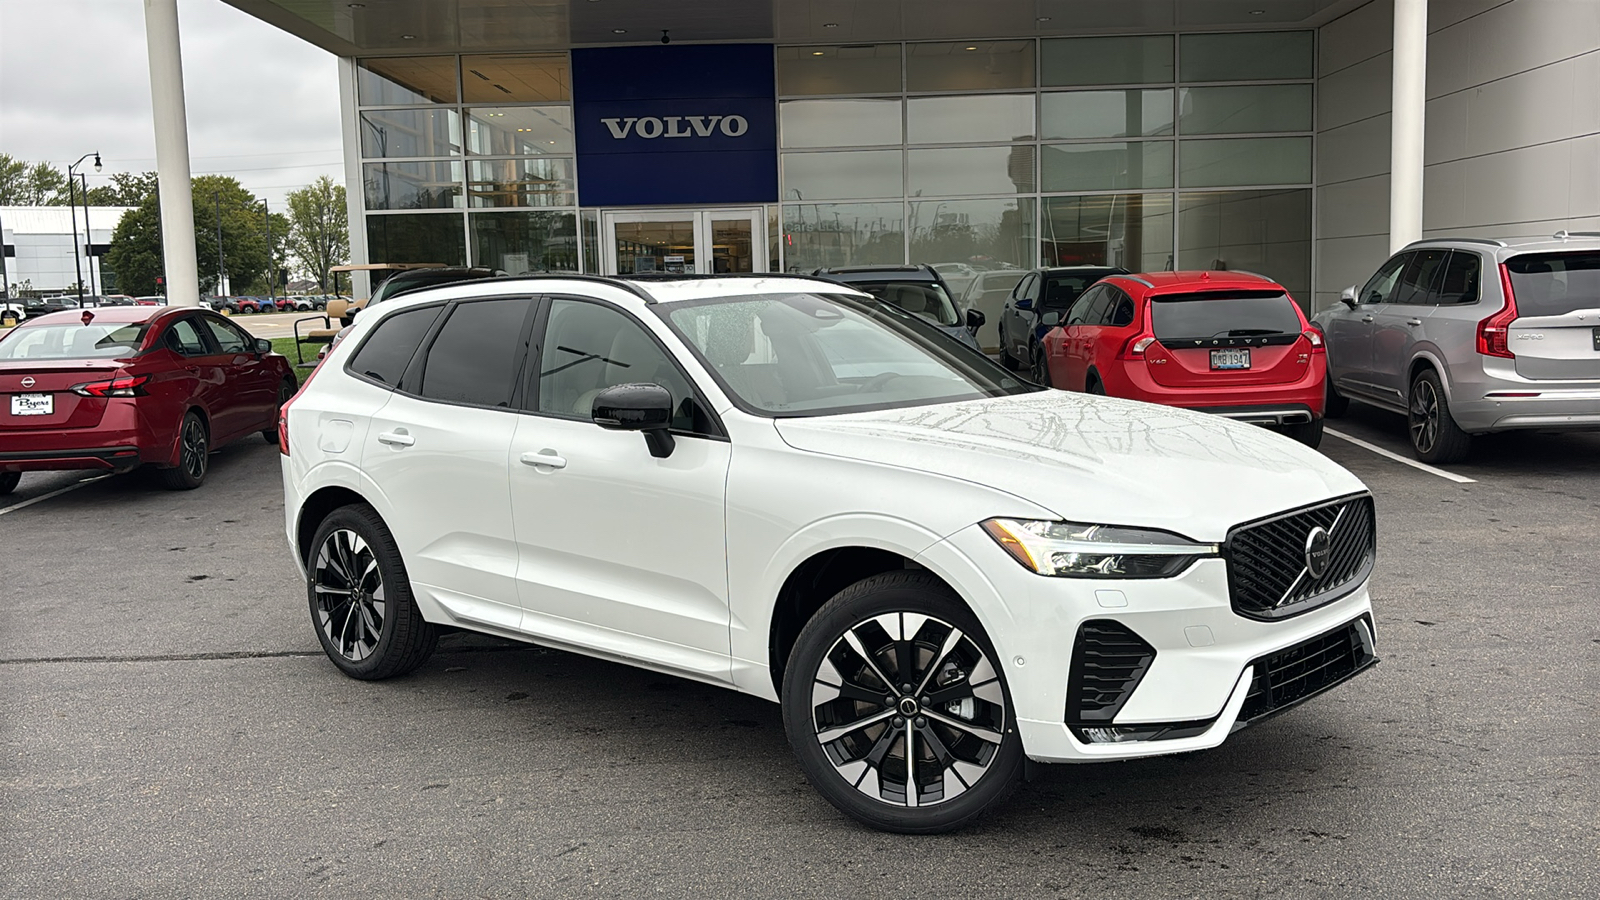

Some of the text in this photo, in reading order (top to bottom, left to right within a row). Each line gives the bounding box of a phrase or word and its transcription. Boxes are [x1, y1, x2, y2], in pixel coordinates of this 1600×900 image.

[600, 115, 749, 139] VOLVO
[784, 222, 814, 232] Cars
[1516, 333, 1544, 341] XC90
[1194, 338, 1268, 346] VOLVO
